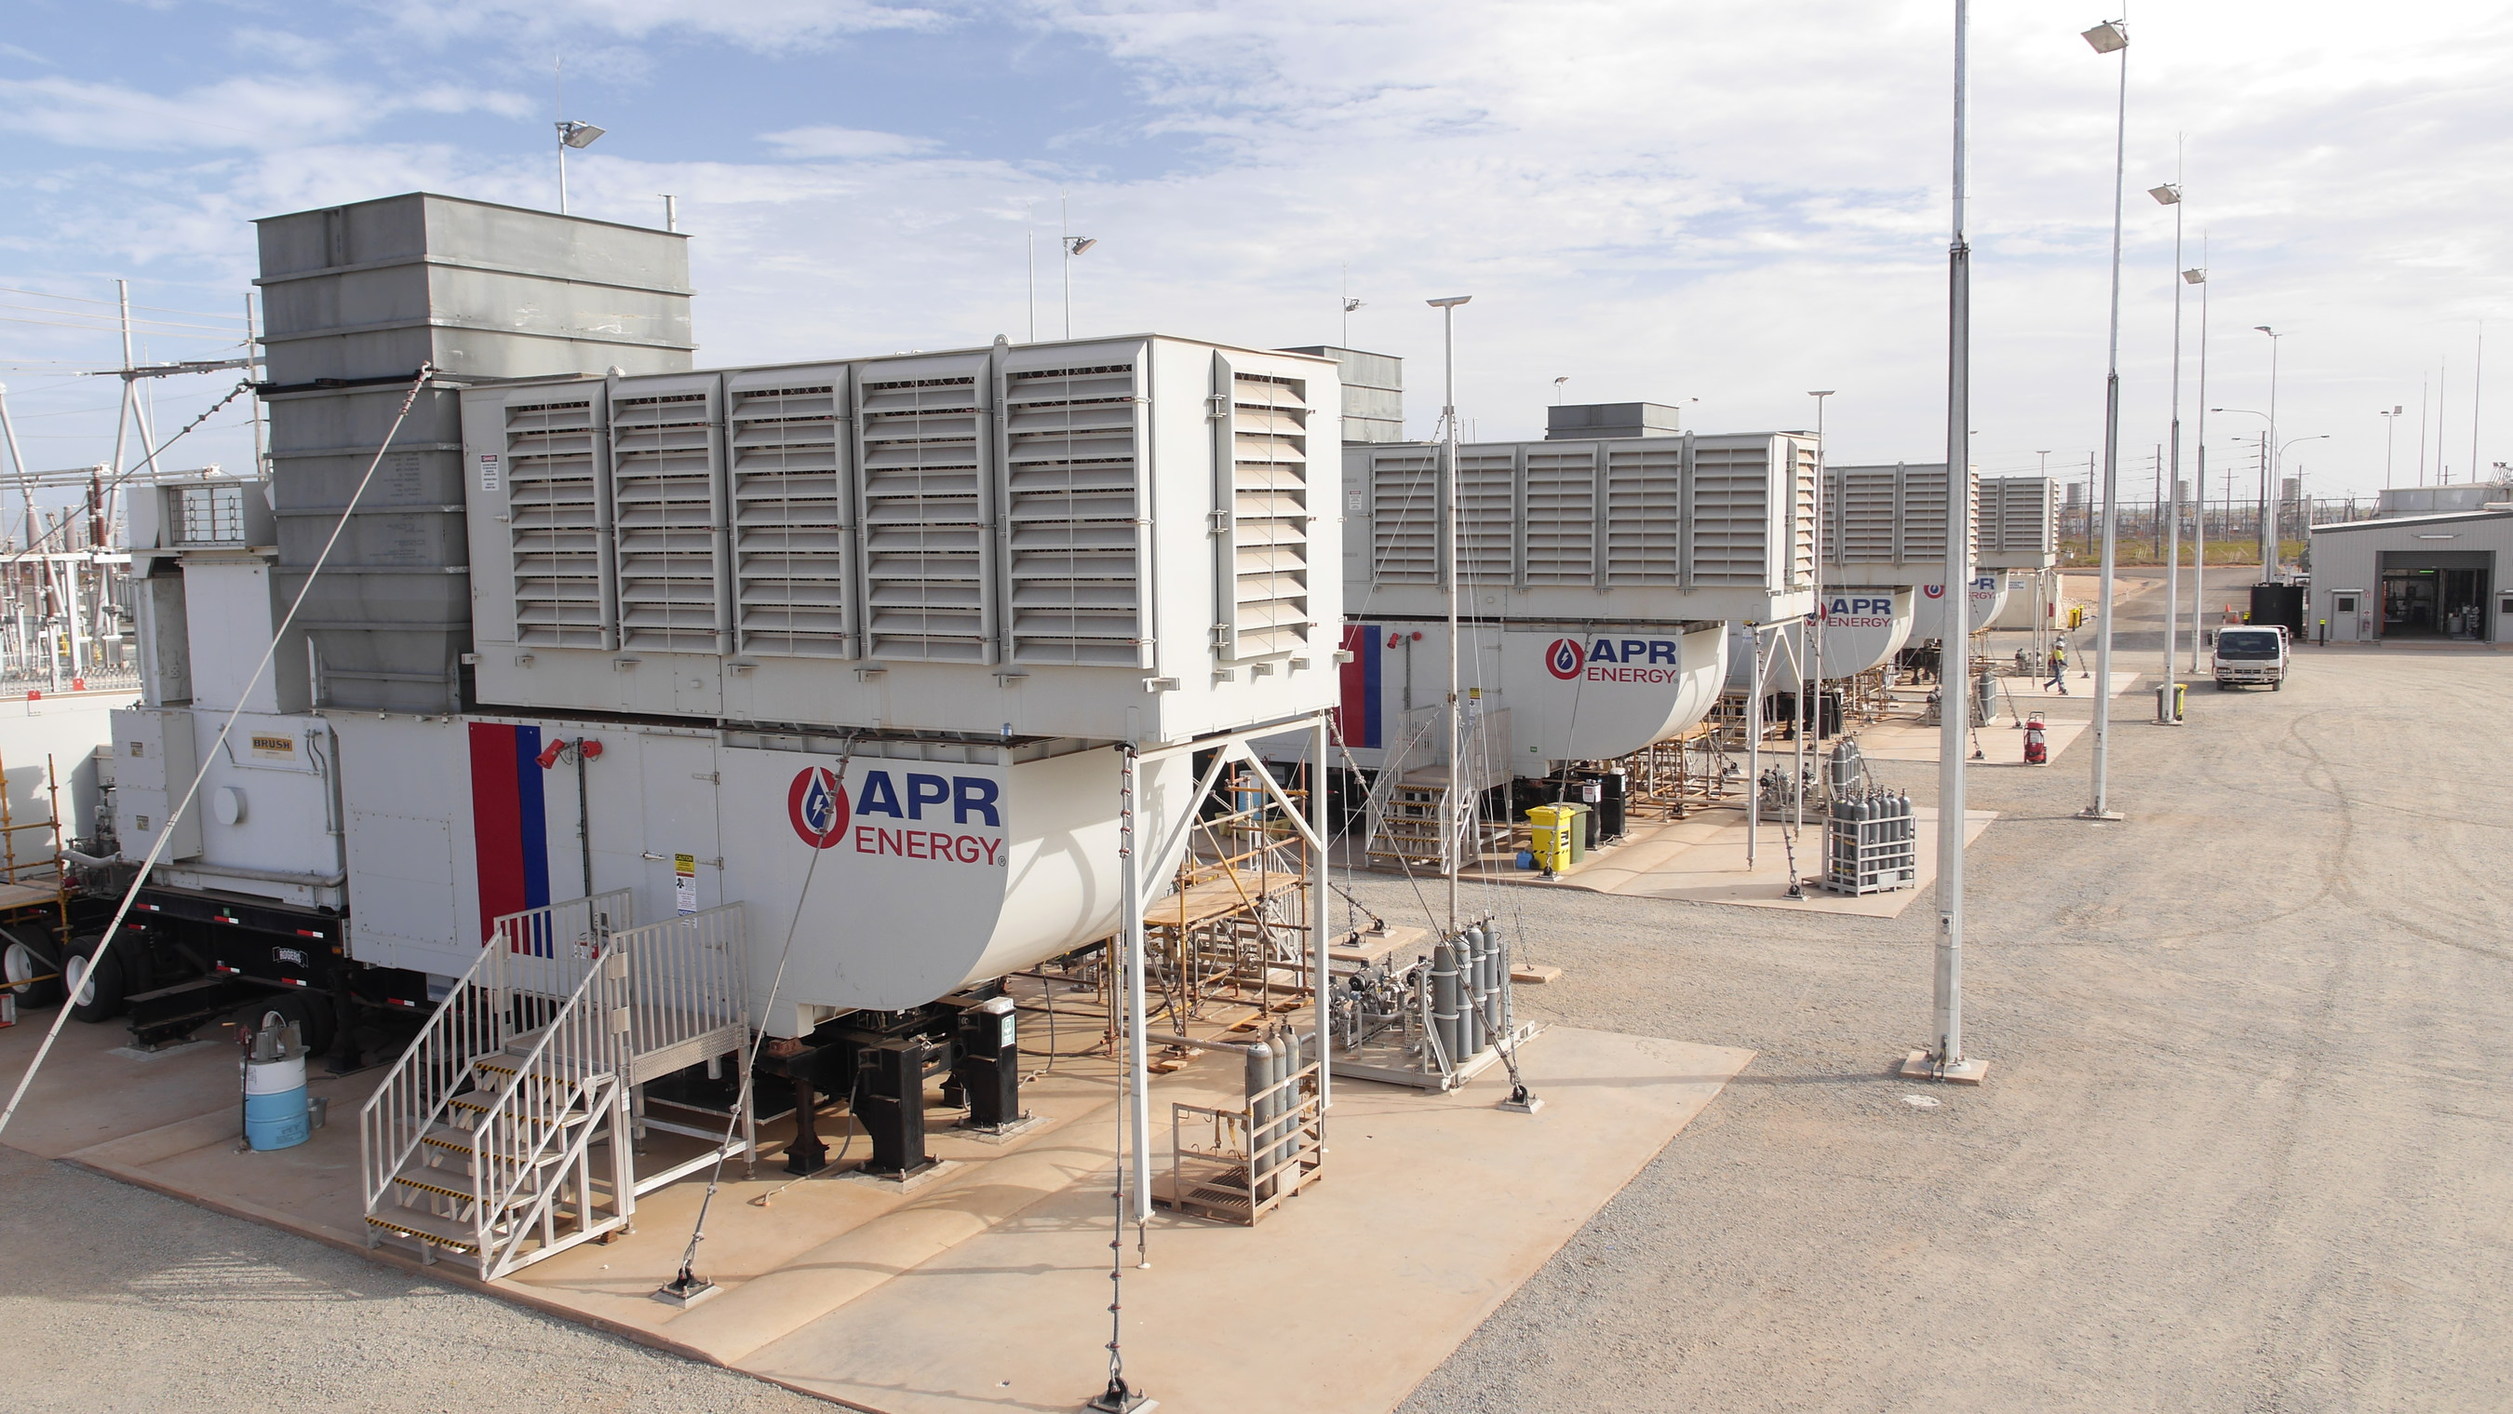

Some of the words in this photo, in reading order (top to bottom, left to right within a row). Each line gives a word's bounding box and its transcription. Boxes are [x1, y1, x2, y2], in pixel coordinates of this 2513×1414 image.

[1831, 598, 1892, 615] APR
[1828, 617, 1892, 628] ENERGY
[1588, 639, 1677, 665] APR
[1587, 667, 1677, 684] ENERGY
[253, 739, 291, 750] BRUSH
[855, 770, 1001, 827] APR
[855, 826, 1002, 866] ENERGY
